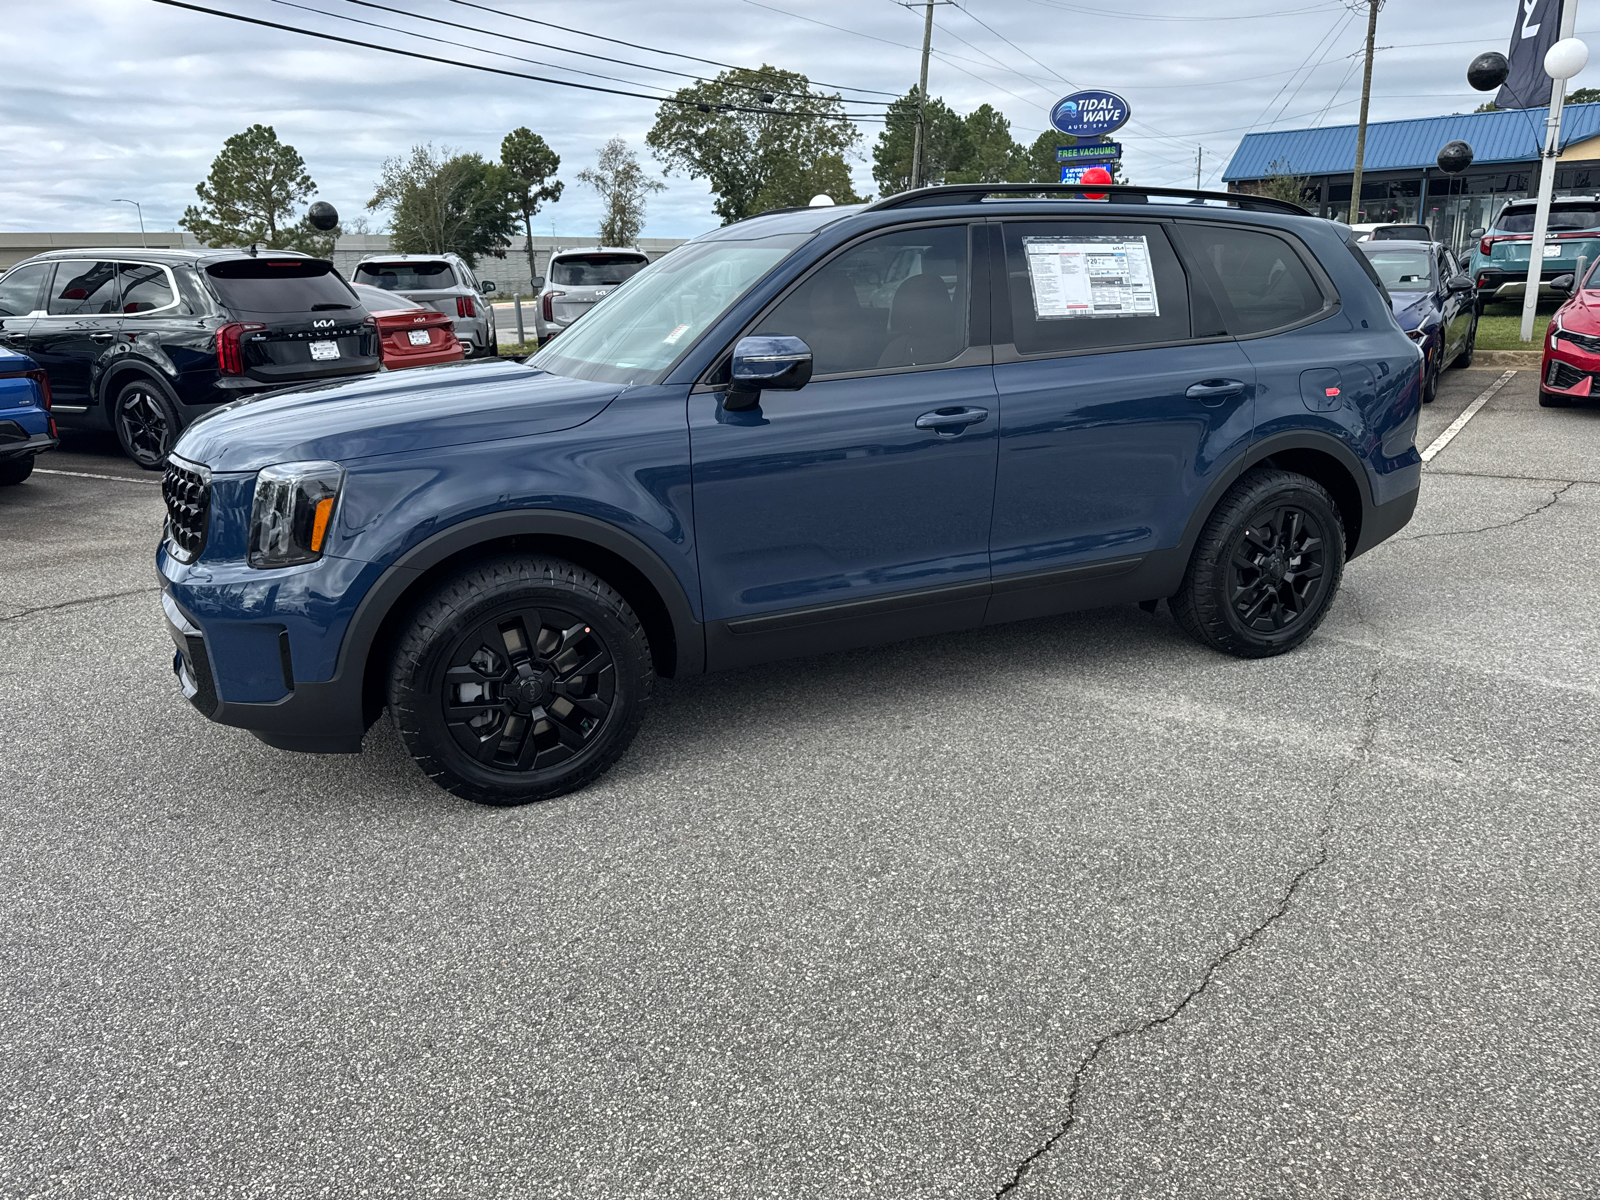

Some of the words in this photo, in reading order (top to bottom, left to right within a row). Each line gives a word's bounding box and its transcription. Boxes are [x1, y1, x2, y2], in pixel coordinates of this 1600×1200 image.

[1078, 98, 1114, 111] TIDAL
[1083, 109, 1121, 122] WAVE
[1080, 146, 1115, 155] VACUUMS
[313, 319, 335, 328] KIA
